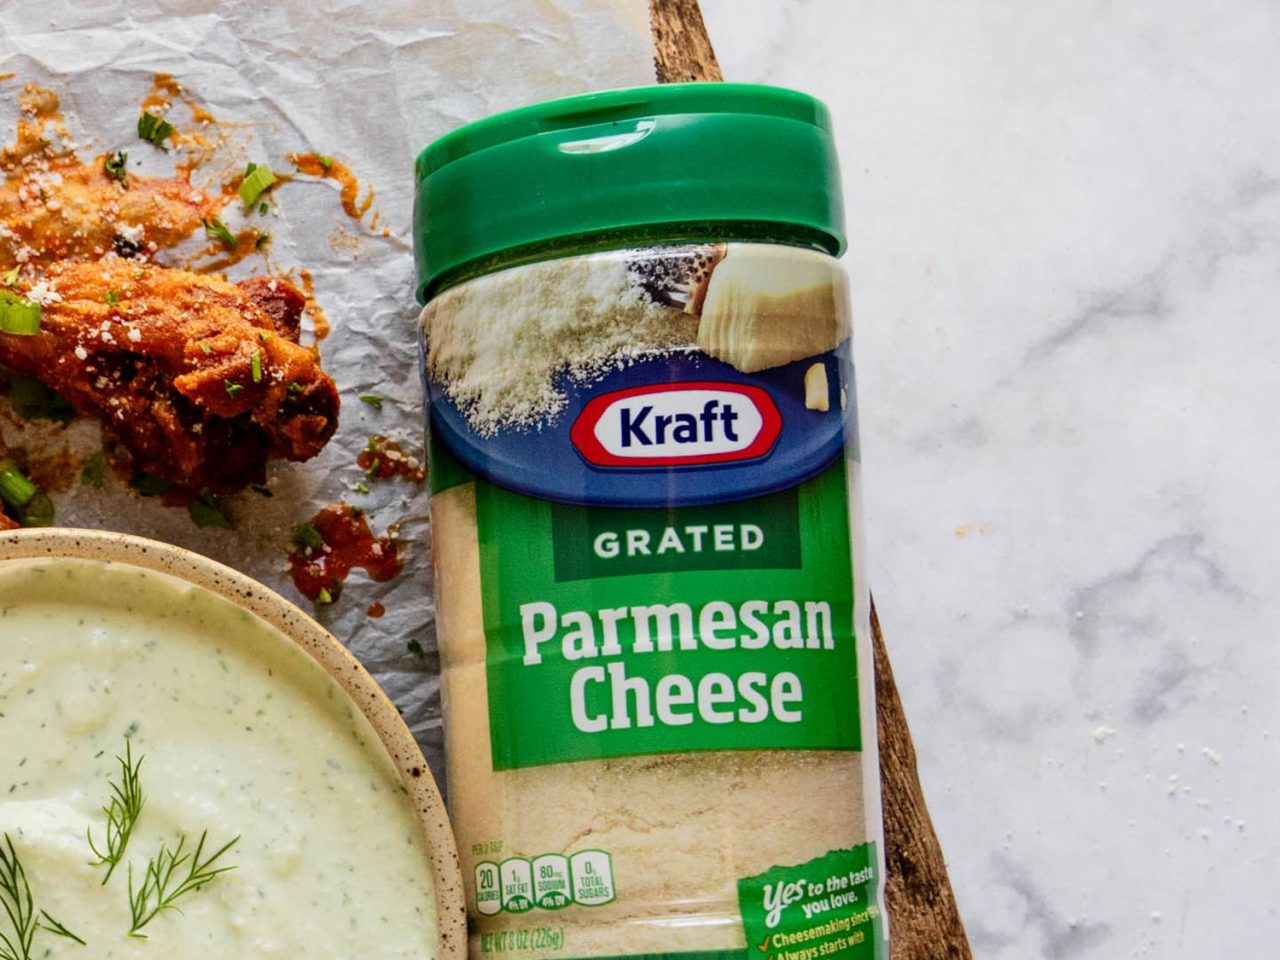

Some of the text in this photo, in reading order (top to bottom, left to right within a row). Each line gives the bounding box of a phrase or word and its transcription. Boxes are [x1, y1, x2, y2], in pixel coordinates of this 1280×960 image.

[621, 399, 739, 448] Kraft
[593, 523, 765, 559] GRATED
[520, 600, 835, 666] Parmesan
[569, 661, 803, 733] Cheese
[480, 869, 493, 889] 20
[538, 879, 566, 892] SODIUM
[578, 887, 609, 899] SUGARS
[580, 877, 604, 887] TOTAL
[808, 883, 824, 896] to
[826, 876, 848, 892] the
[849, 866, 873, 885] taste
[802, 891, 858, 919] you love.
[531, 927, 564, 951] (226g)
[772, 918, 851, 948] Cheesemaking
[819, 938, 847, 955] starts
[847, 929, 865, 946] with
